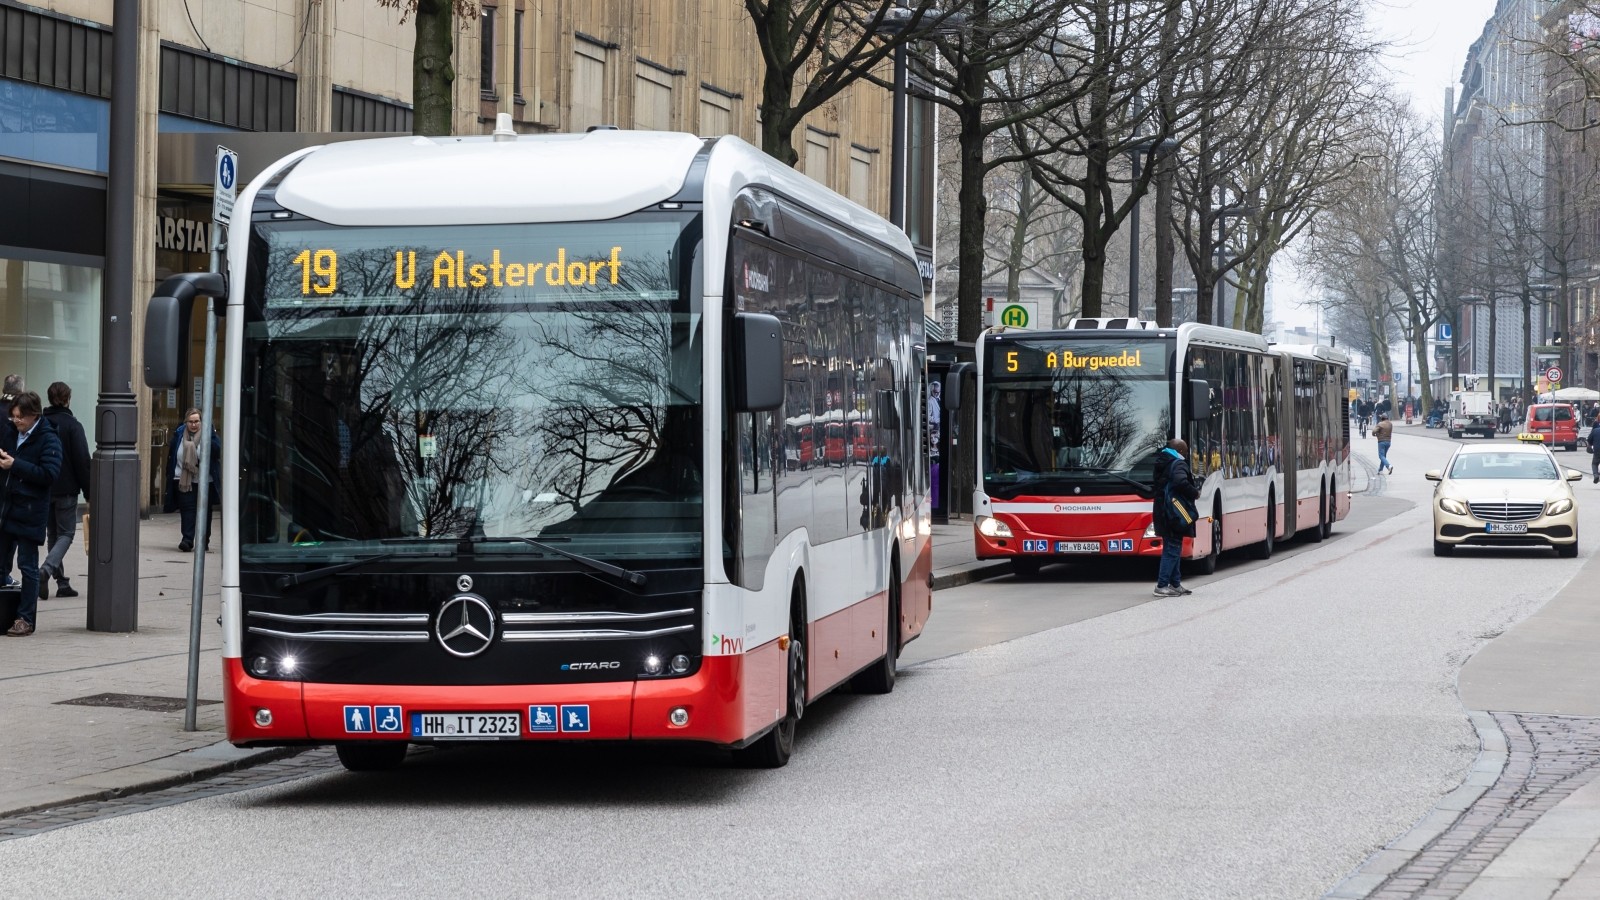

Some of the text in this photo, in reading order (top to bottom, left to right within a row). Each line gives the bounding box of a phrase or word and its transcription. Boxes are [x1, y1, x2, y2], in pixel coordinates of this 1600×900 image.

[292, 246, 622, 294] 19 U Alsterdorf
[1008, 311, 1022, 326] H
[1442, 325, 1452, 339] U
[1007, 350, 1142, 372] 5 A Burgwedel
[1549, 371, 1559, 379] 25
[1059, 543, 1069, 551] HH
[1082, 543, 1099, 551] 4804
[424, 716, 445, 734] HH
[456, 716, 475, 734] IT
[478, 716, 518, 734] 2323
